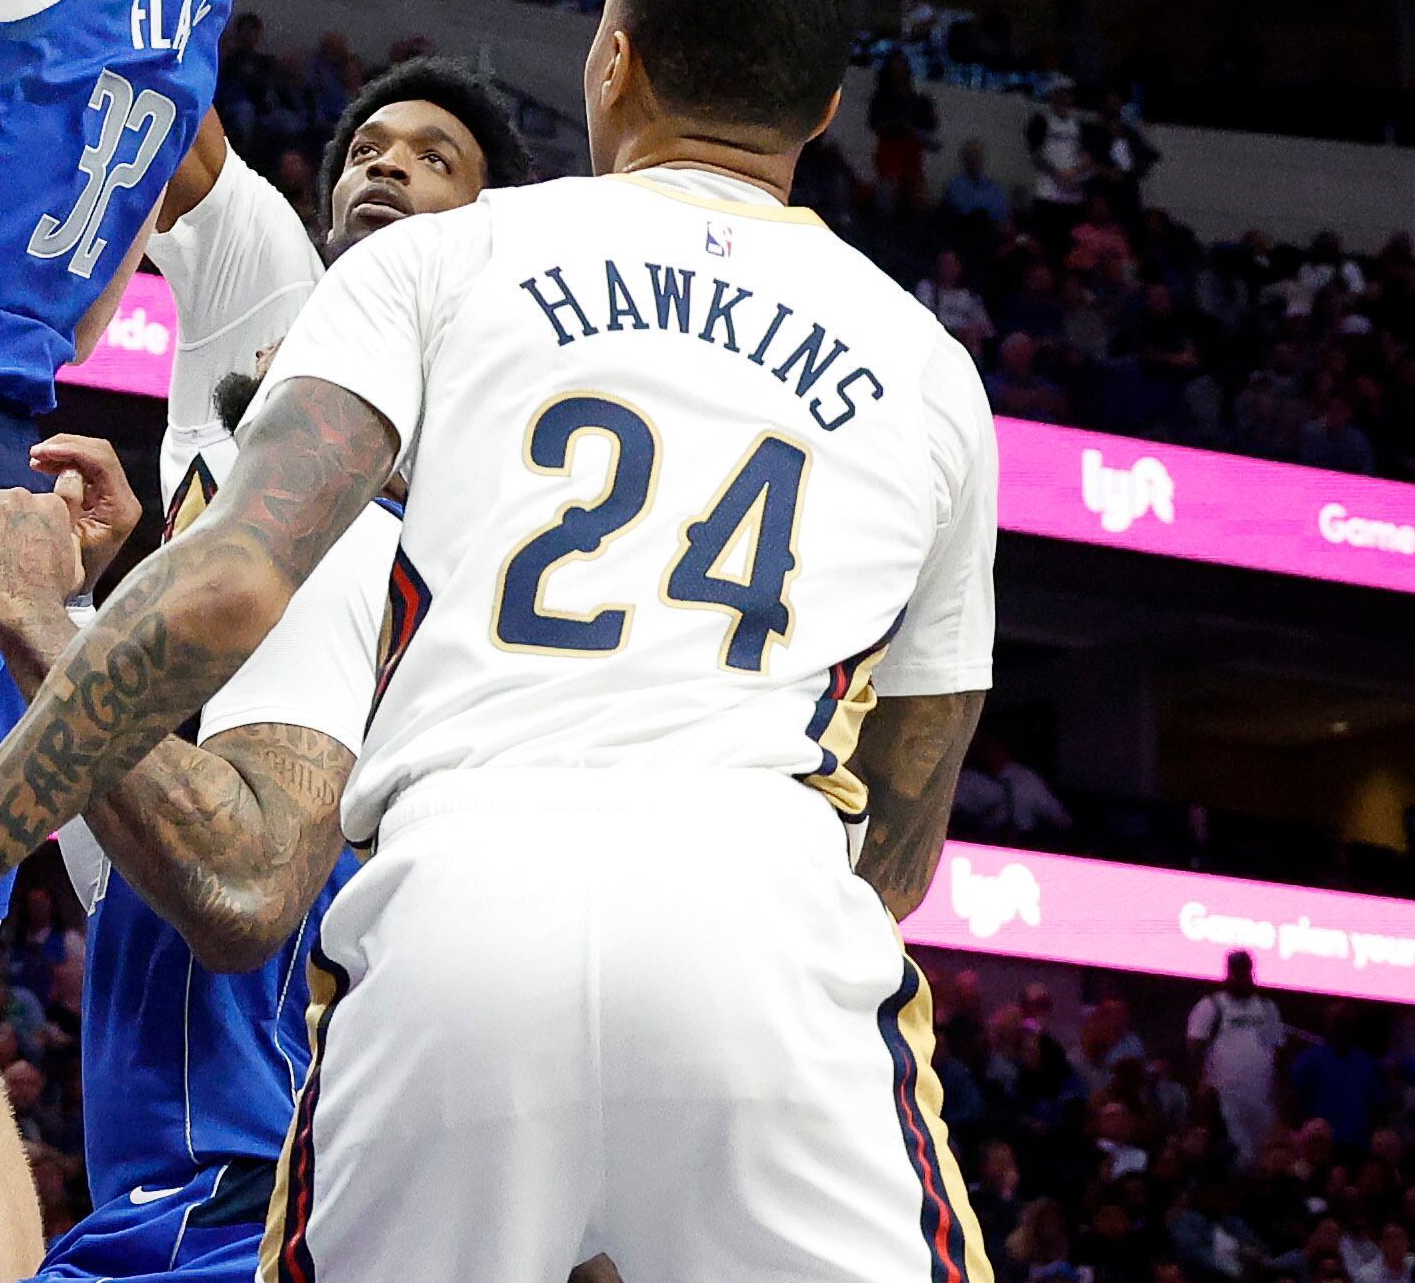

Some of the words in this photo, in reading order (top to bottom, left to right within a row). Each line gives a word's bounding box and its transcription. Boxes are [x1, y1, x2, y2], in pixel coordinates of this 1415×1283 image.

[26, 67, 177, 279] 32
[107, 306, 170, 356] ide
[519, 259, 884, 432] HAWKINS
[489, 388, 814, 676] 24
[80, 610, 168, 731] GOD
